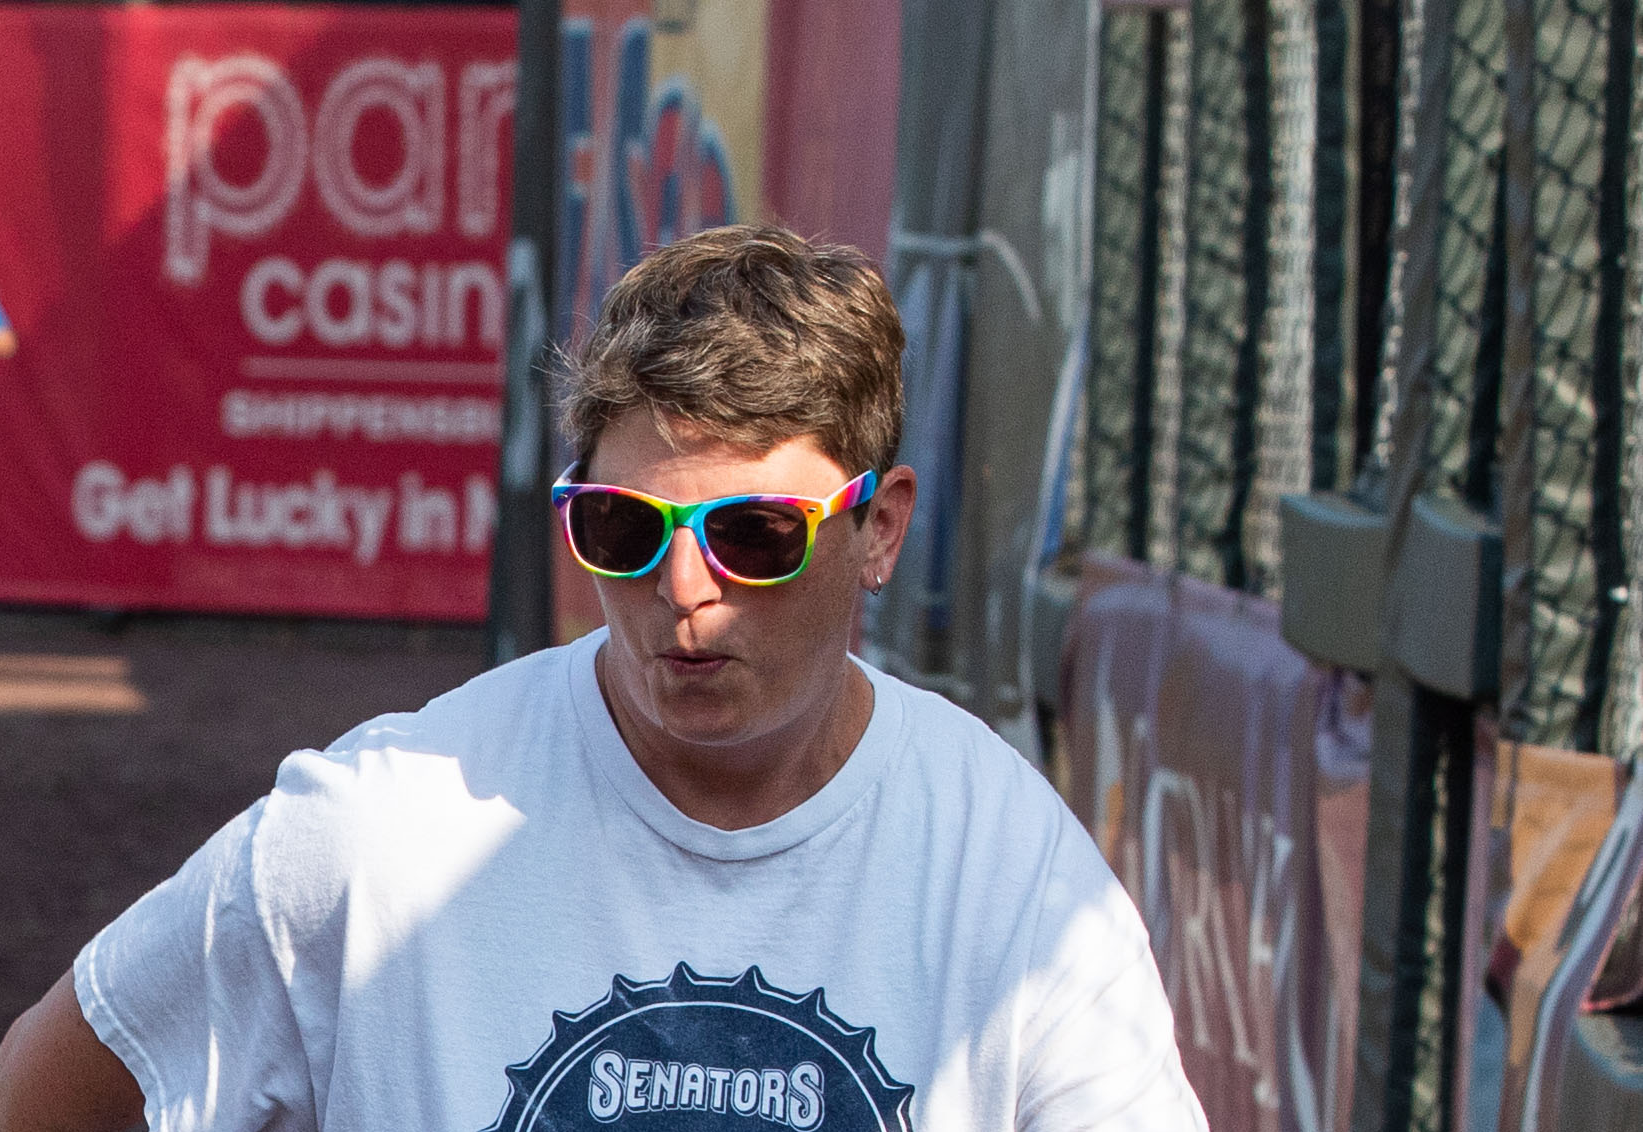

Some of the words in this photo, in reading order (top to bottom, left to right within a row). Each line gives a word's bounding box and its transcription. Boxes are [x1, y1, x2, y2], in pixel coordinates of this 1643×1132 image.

[241, 258, 504, 348] casin
[72, 461, 195, 542] Get
[206, 464, 392, 566] Lucky
[399, 470, 456, 553] in
[589, 1050, 826, 1132] SENATORS
